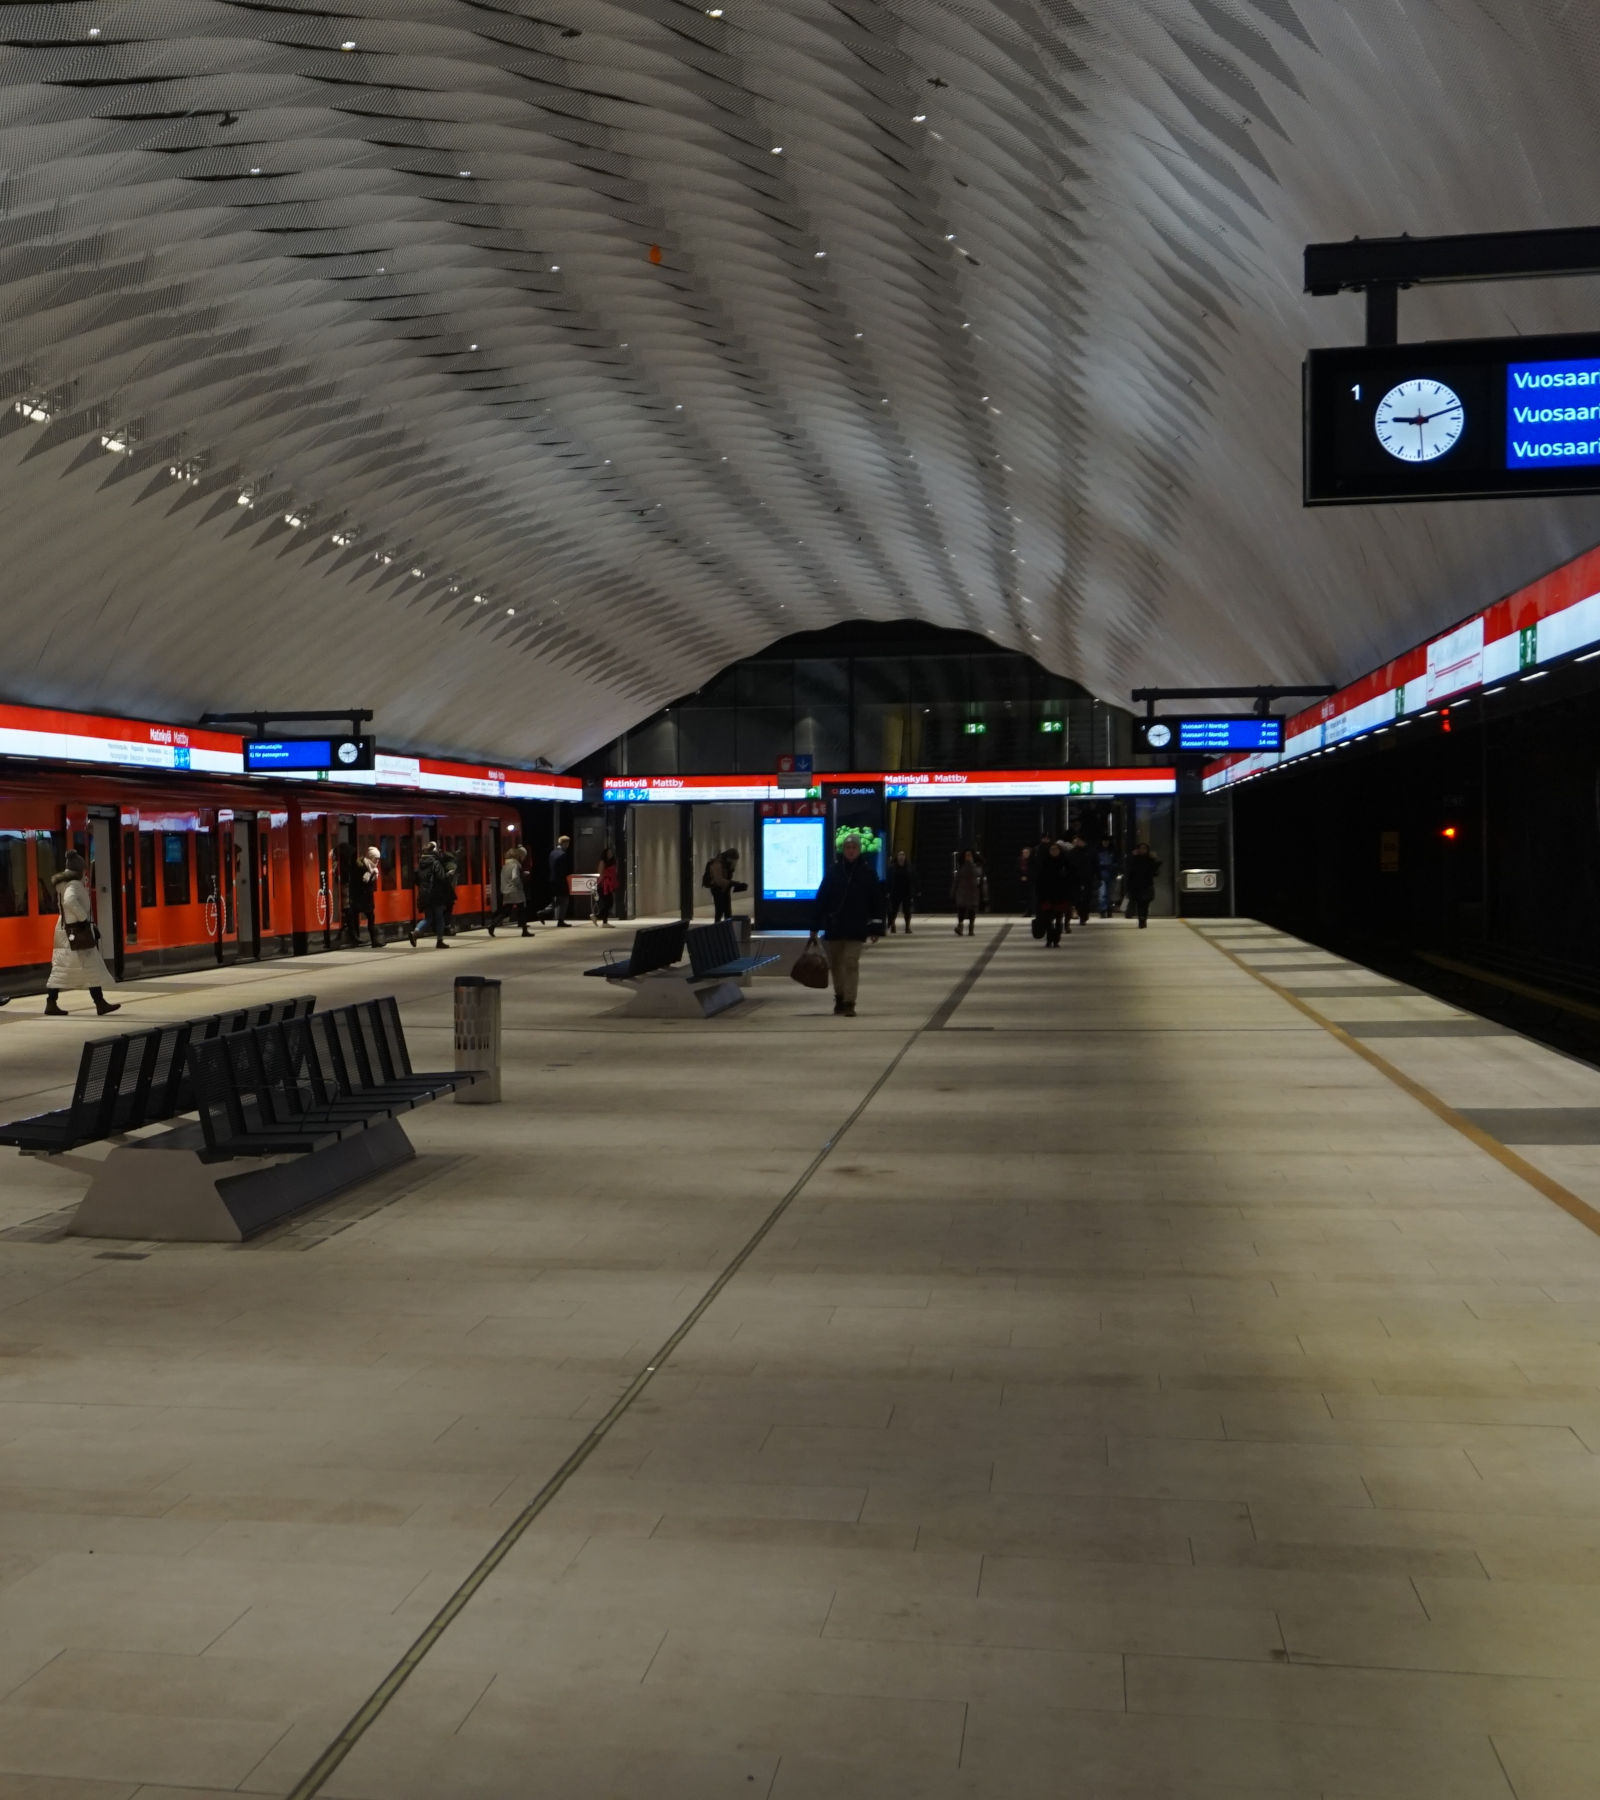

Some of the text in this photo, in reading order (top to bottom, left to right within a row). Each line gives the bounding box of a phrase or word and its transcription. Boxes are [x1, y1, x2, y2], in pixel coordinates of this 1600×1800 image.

[1351, 384, 1361, 401] 1
[605, 778, 684, 789] Matinkylä Mattby
[885, 774, 968, 784] Matinkylä Mattby
